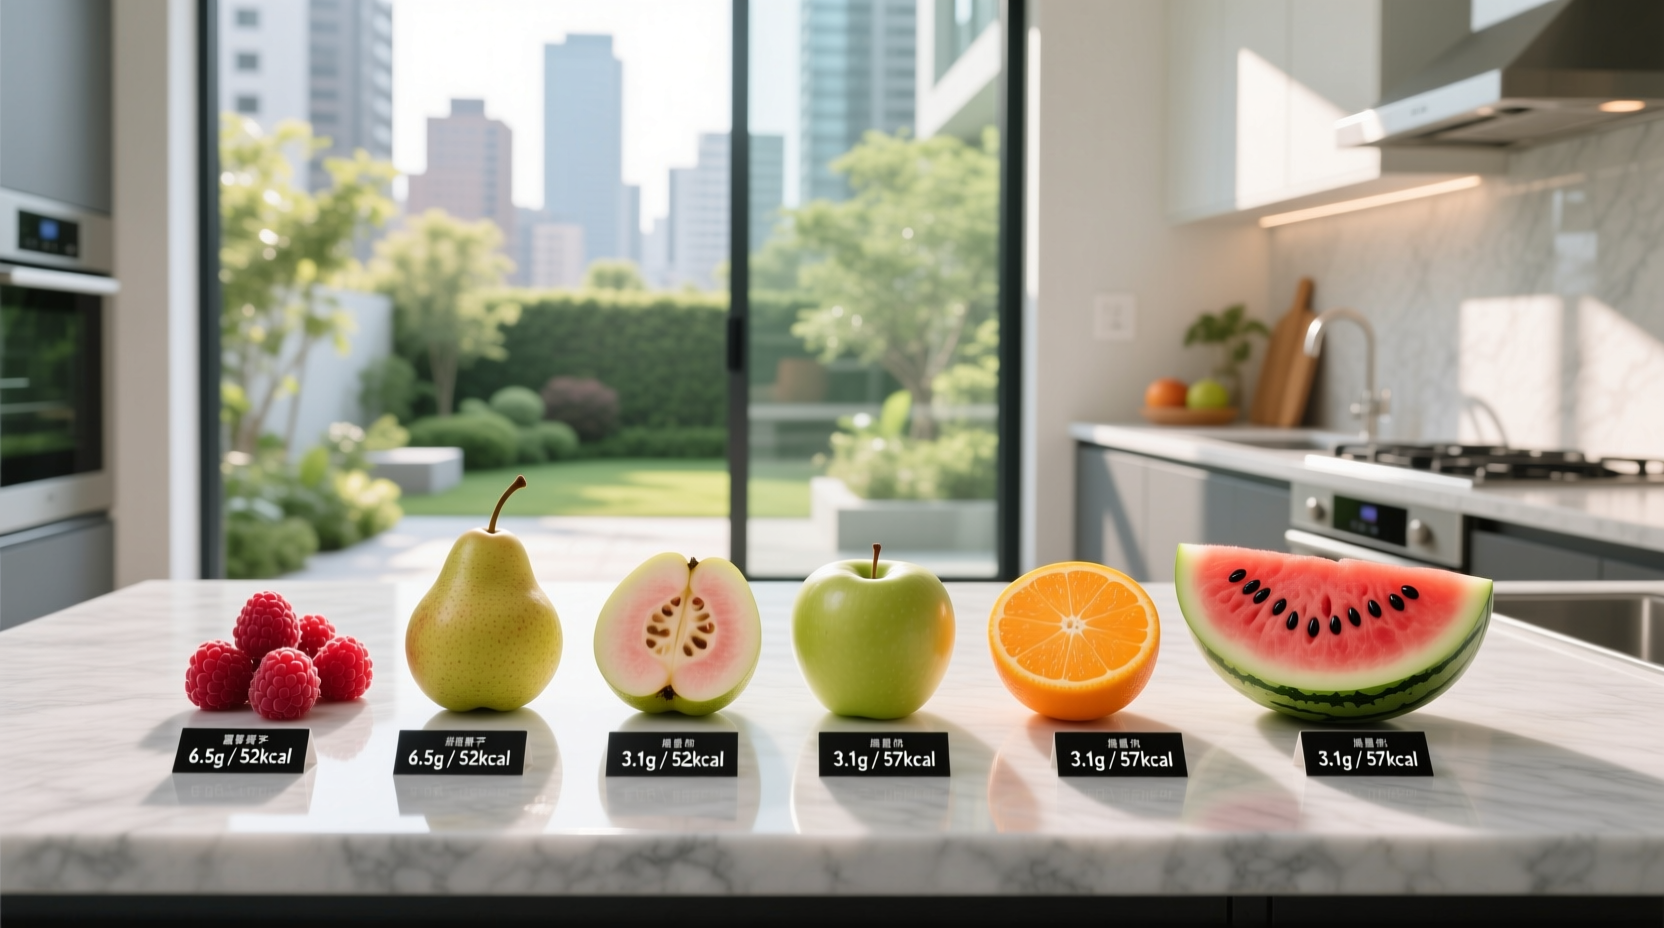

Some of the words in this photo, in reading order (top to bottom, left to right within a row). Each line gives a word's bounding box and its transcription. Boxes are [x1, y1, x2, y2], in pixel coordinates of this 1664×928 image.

[189, 748, 224, 768] 6.5g
[240, 748, 292, 764] 52kcal
[409, 750, 444, 770] 6.5g
[459, 750, 510, 765] 52kcal
[622, 751, 656, 771] 3.1g
[673, 751, 724, 767] 52kcal
[834, 751, 868, 771] 3.1g
[884, 751, 936, 767] 57kcal
[1071, 751, 1105, 771] 3.1g
[1121, 751, 1173, 767] 57kcal
[1319, 751, 1352, 771] 3.1g
[1367, 751, 1418, 767] 57kcal
